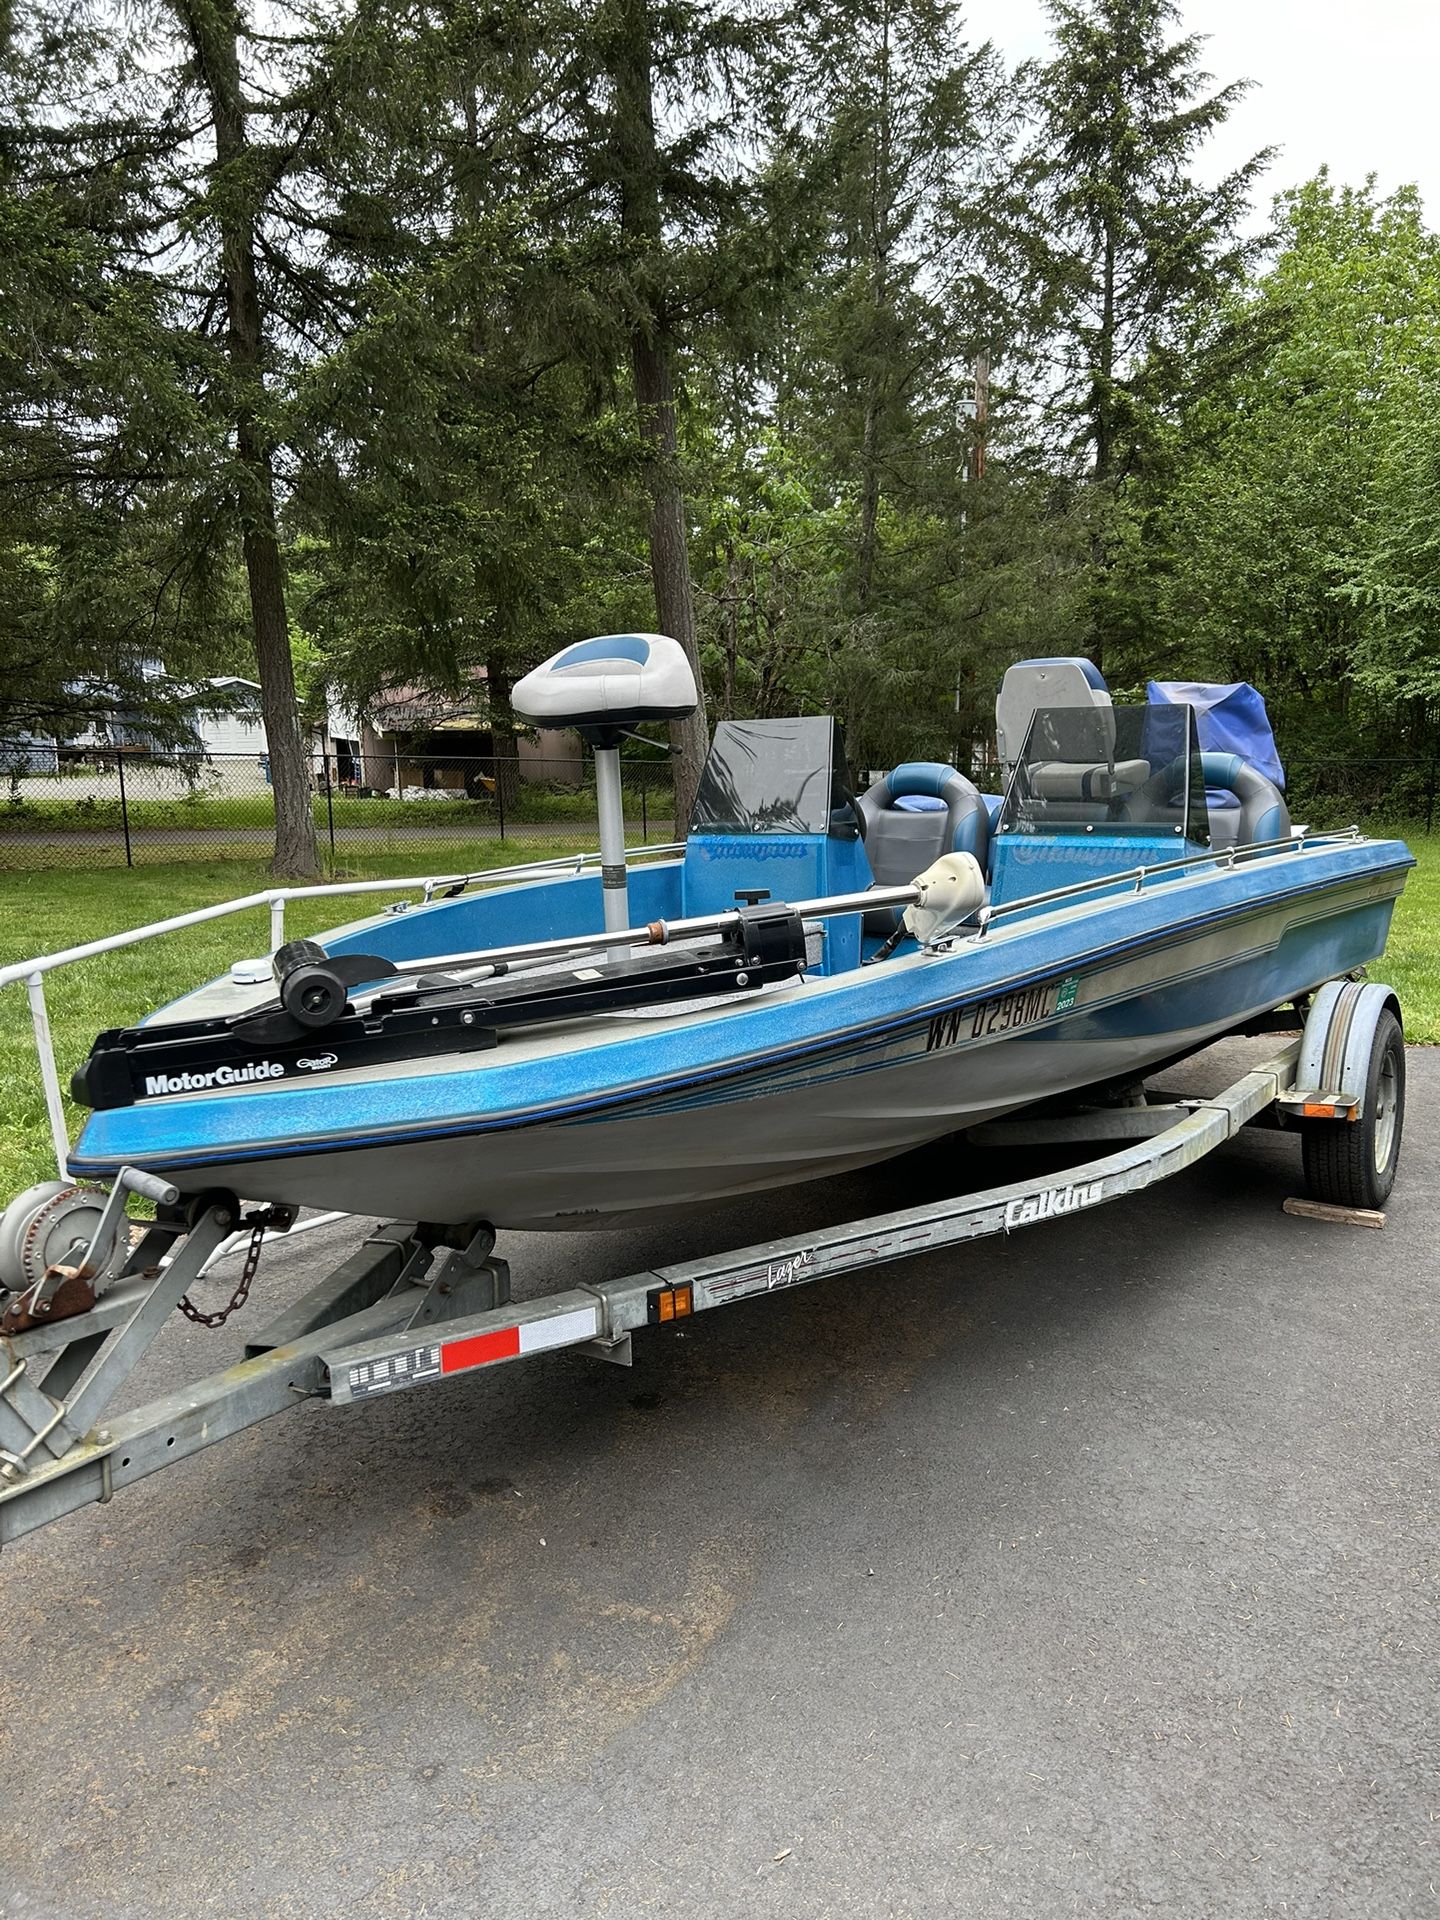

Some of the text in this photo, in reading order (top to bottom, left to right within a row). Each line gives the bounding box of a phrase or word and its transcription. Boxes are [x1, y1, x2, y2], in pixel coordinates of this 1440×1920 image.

[926, 1009, 964, 1053] WN
[145, 1060, 285, 1096] MotorGuide
[1004, 1182, 1103, 1227] Calkins
[767, 1250, 812, 1289] Lazer
